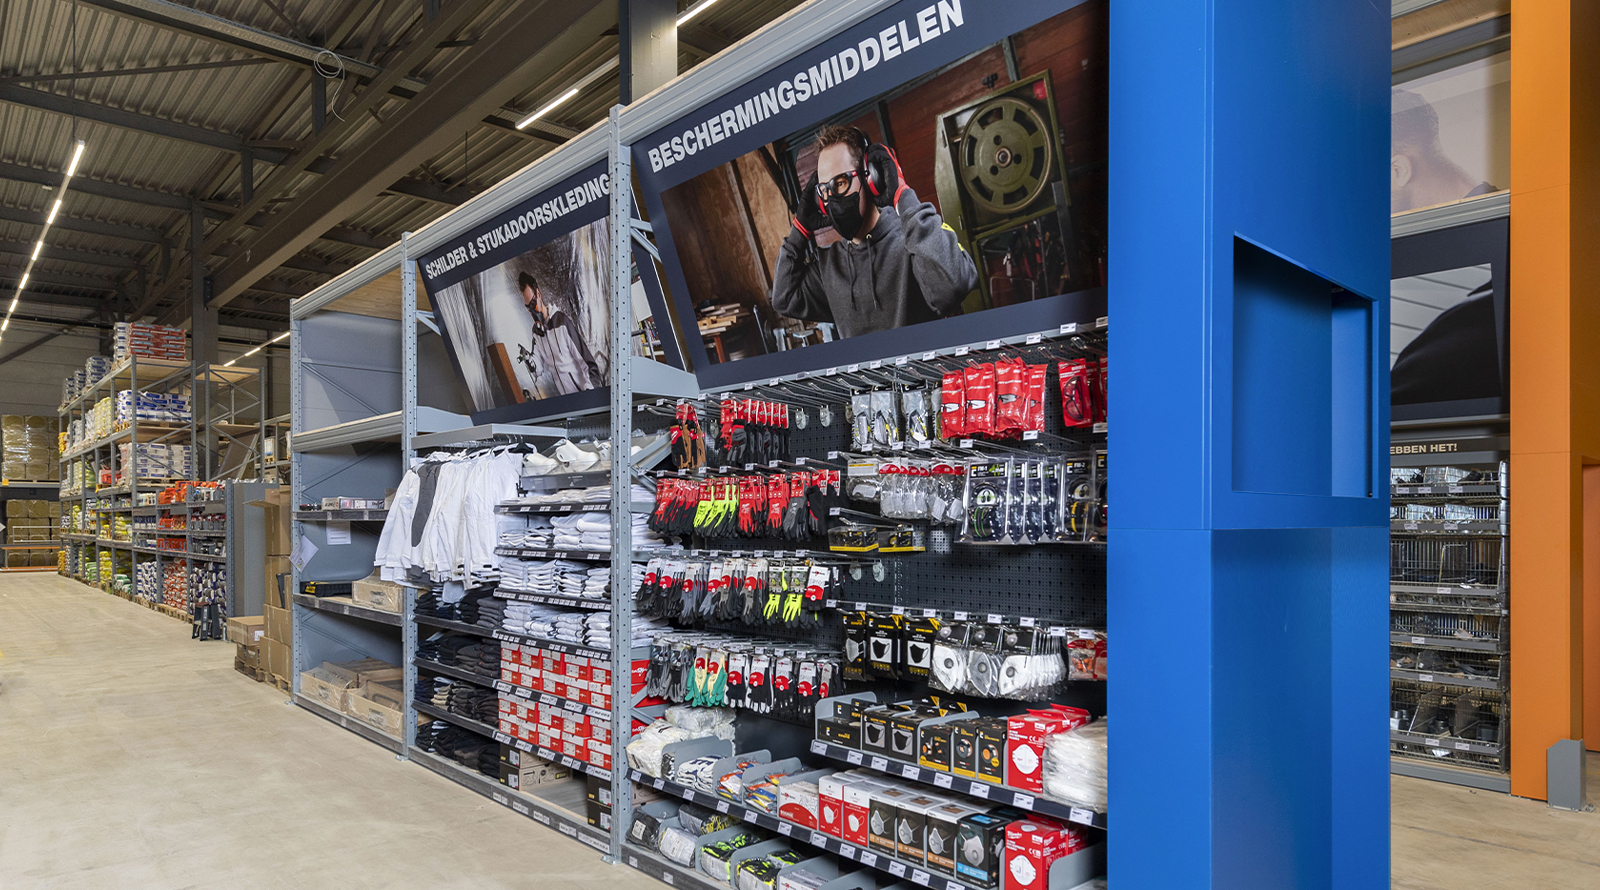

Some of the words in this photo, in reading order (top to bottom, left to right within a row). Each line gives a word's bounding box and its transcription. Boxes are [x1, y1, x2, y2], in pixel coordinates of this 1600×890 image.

[648, 0, 964, 173] BESCHERMINGSMIDDELEN
[425, 246, 469, 280] SCHILDER
[467, 241, 478, 259] &
[476, 173, 610, 255] STUKADOORSKLEDING
[1430, 443, 1457, 452] HET!
